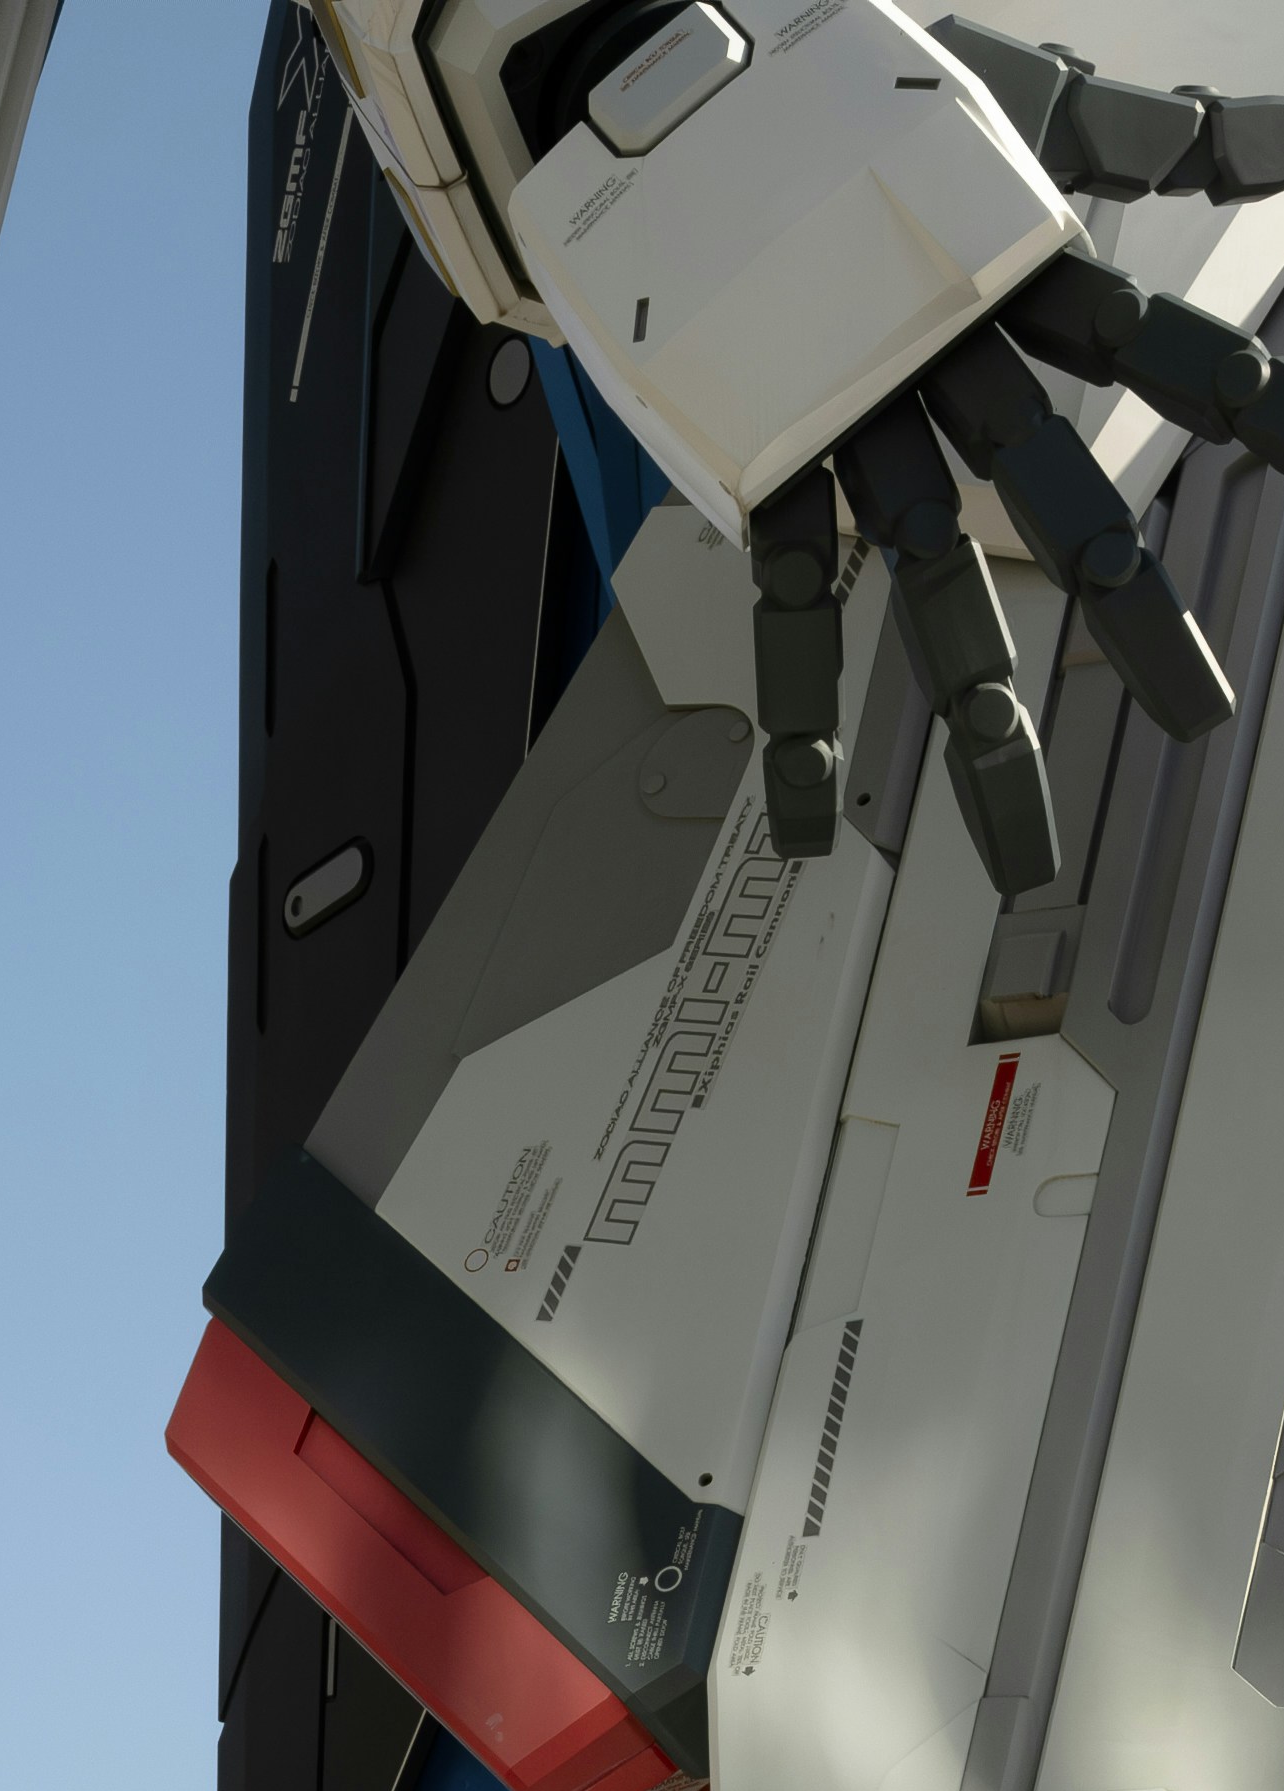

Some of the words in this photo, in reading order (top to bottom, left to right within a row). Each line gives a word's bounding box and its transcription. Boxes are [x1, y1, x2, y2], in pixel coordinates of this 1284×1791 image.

[773, 0, 830, 40] WARNING
[567, 174, 618, 227] WARNING
[593, 1088, 631, 1162] ZODIAC
[625, 994, 673, 1088] ALLIANCE
[677, 869, 726, 965] FREEDOM
[718, 796, 757, 869] TREATY
[697, 1007, 743, 1097] Xiphias
[733, 960, 760, 1007] Rail
[752, 871, 799, 961] Cannon
[482, 1145, 531, 1245] CAUTION
[607, 1569, 629, 1625] WARNING
[749, 1614, 768, 1664] CAUTION
